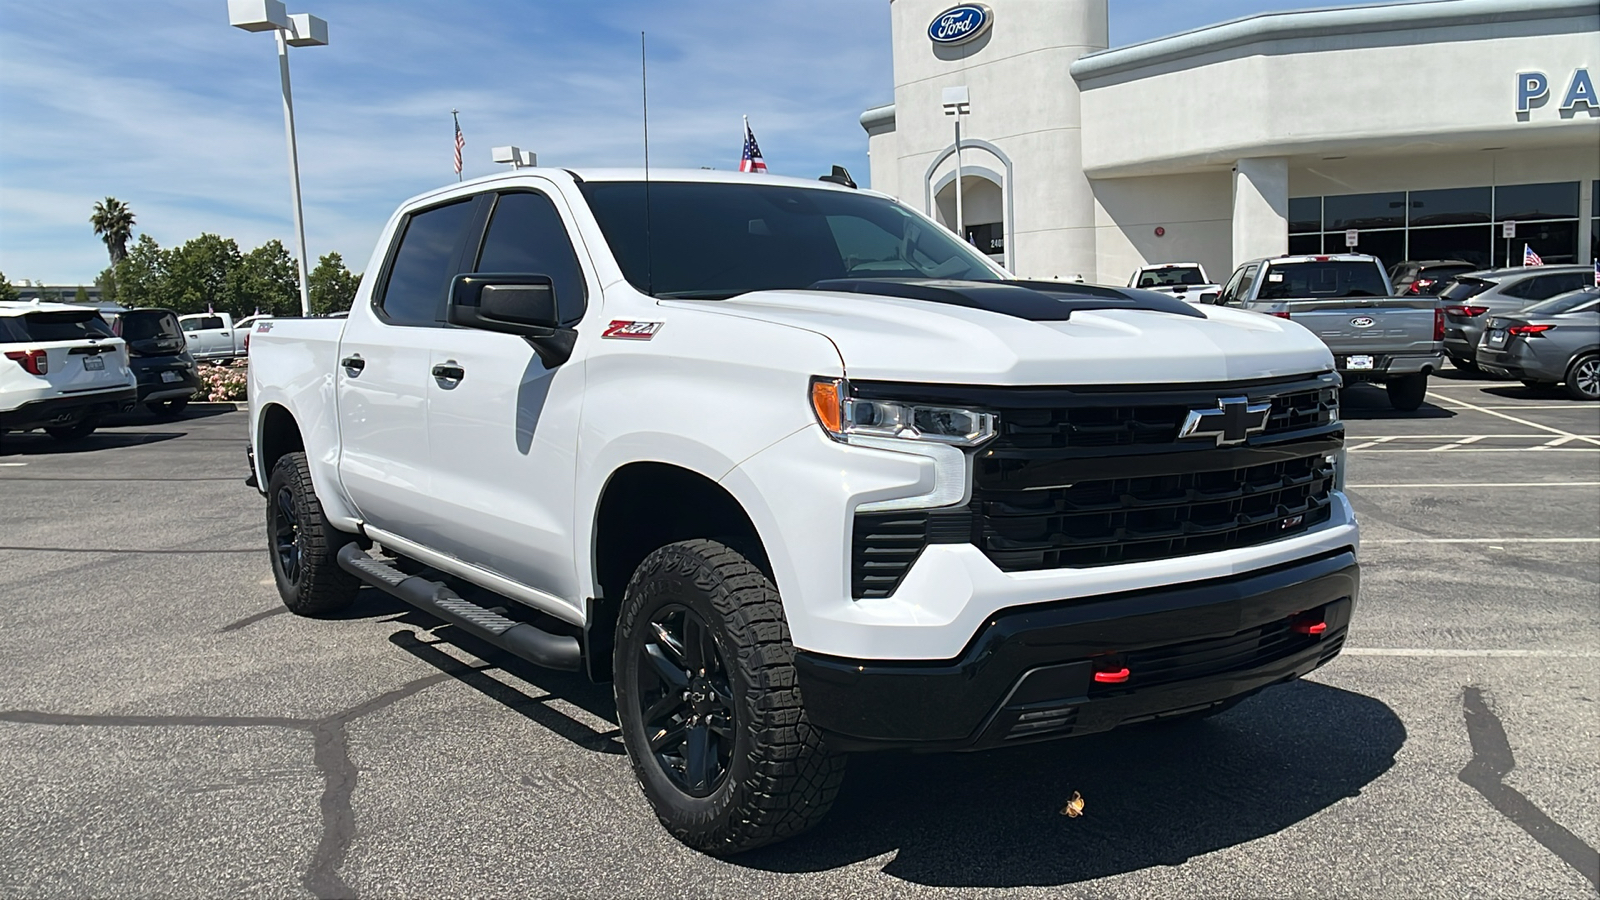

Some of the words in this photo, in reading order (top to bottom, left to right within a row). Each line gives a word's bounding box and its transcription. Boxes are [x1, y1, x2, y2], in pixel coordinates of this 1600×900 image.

[938, 11, 973, 38] Ford
[1516, 68, 1600, 114] PA
[601, 320, 664, 341] Z71
